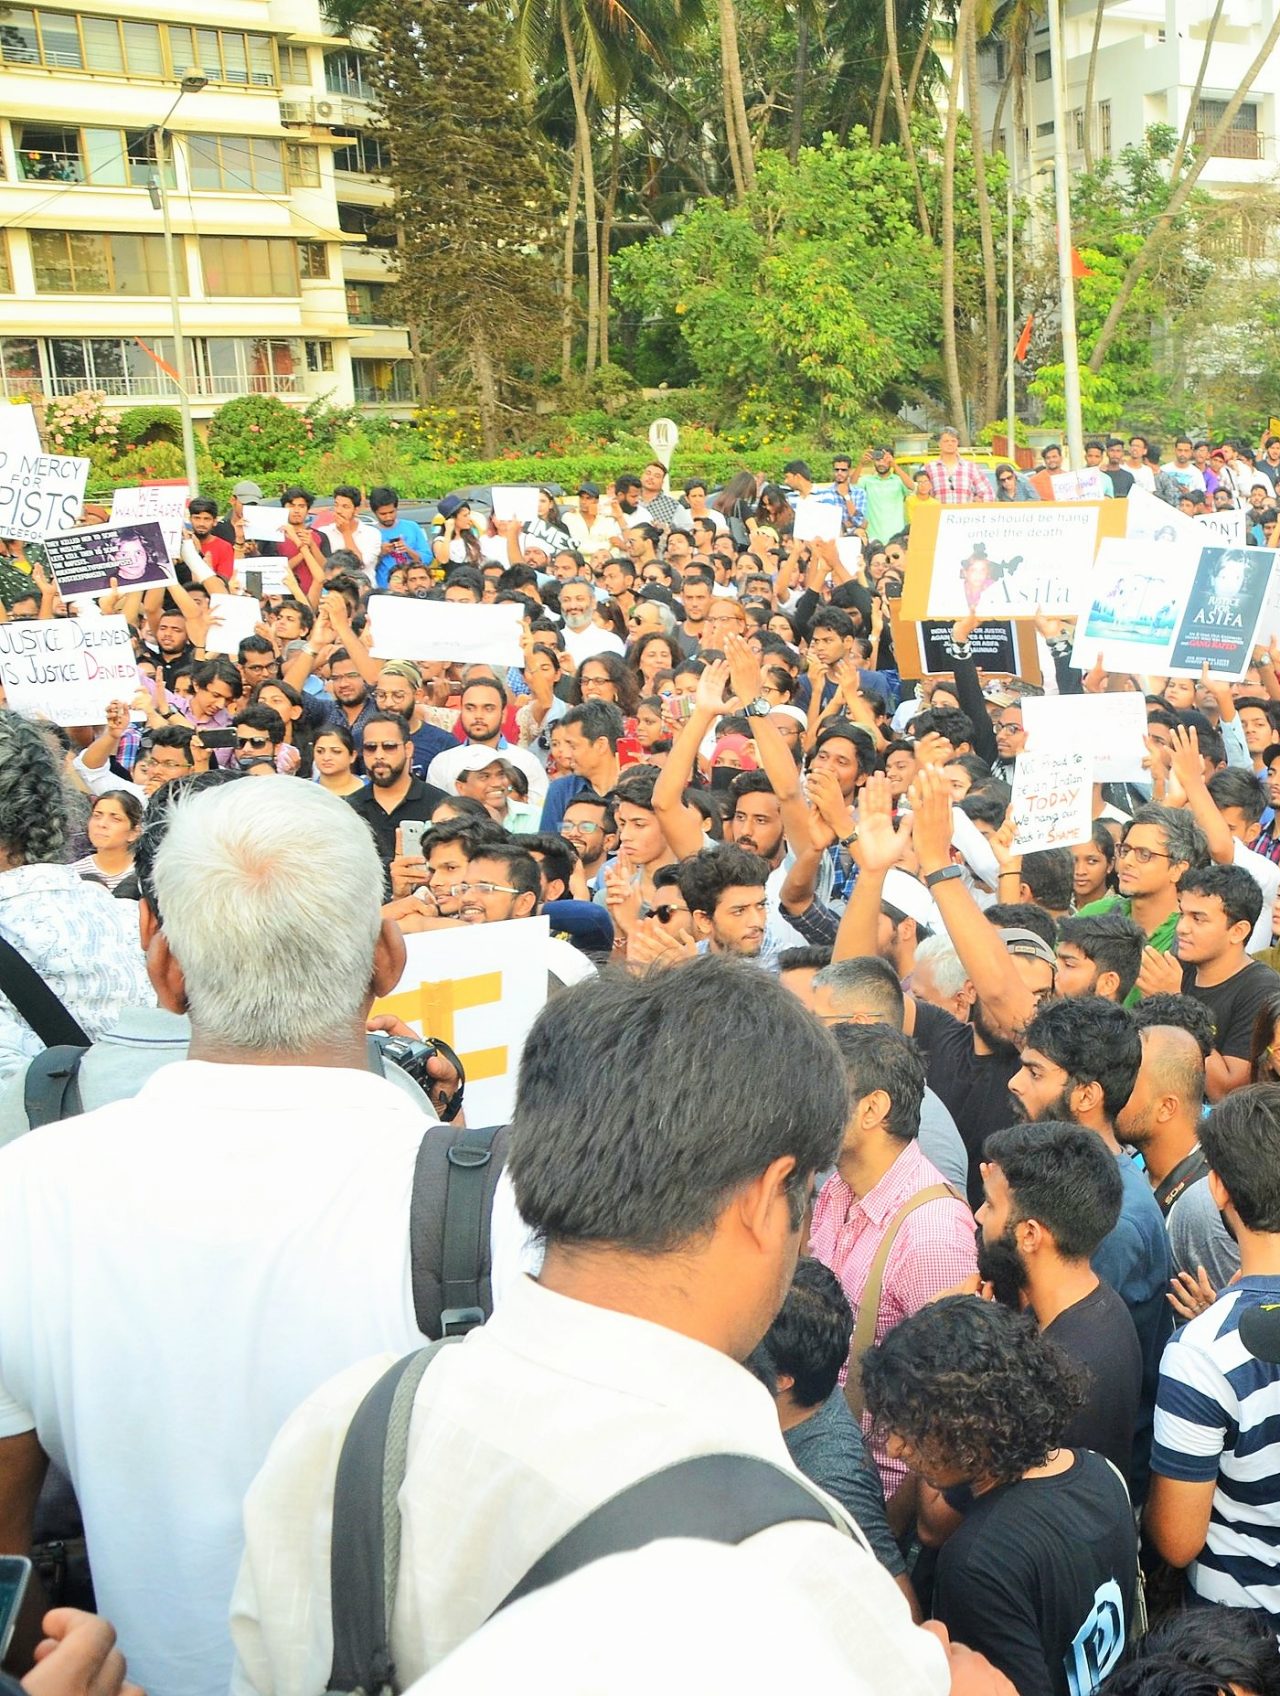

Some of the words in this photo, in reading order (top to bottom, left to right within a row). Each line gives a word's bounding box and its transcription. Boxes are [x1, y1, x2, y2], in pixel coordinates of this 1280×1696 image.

[20, 455, 82, 481] MERCY
[10, 474, 42, 488] FOR
[0, 486, 78, 530] PISTS
[946, 513, 987, 525] Rapist
[989, 512, 1034, 524] should
[1027, 527, 1063, 538] death
[1208, 596, 1240, 607] JUSTICE
[1193, 608, 1243, 627] ASIFA
[0, 623, 64, 654] JUSTICE
[70, 620, 131, 648] DELAYED
[984, 627, 1007, 635] JUSTICE
[1, 662, 19, 685] IS
[24, 654, 80, 684] JUSTICE
[83, 651, 136, 680] DENIED
[1025, 788, 1080, 812] TODAY
[1046, 827, 1080, 843] SHAME
